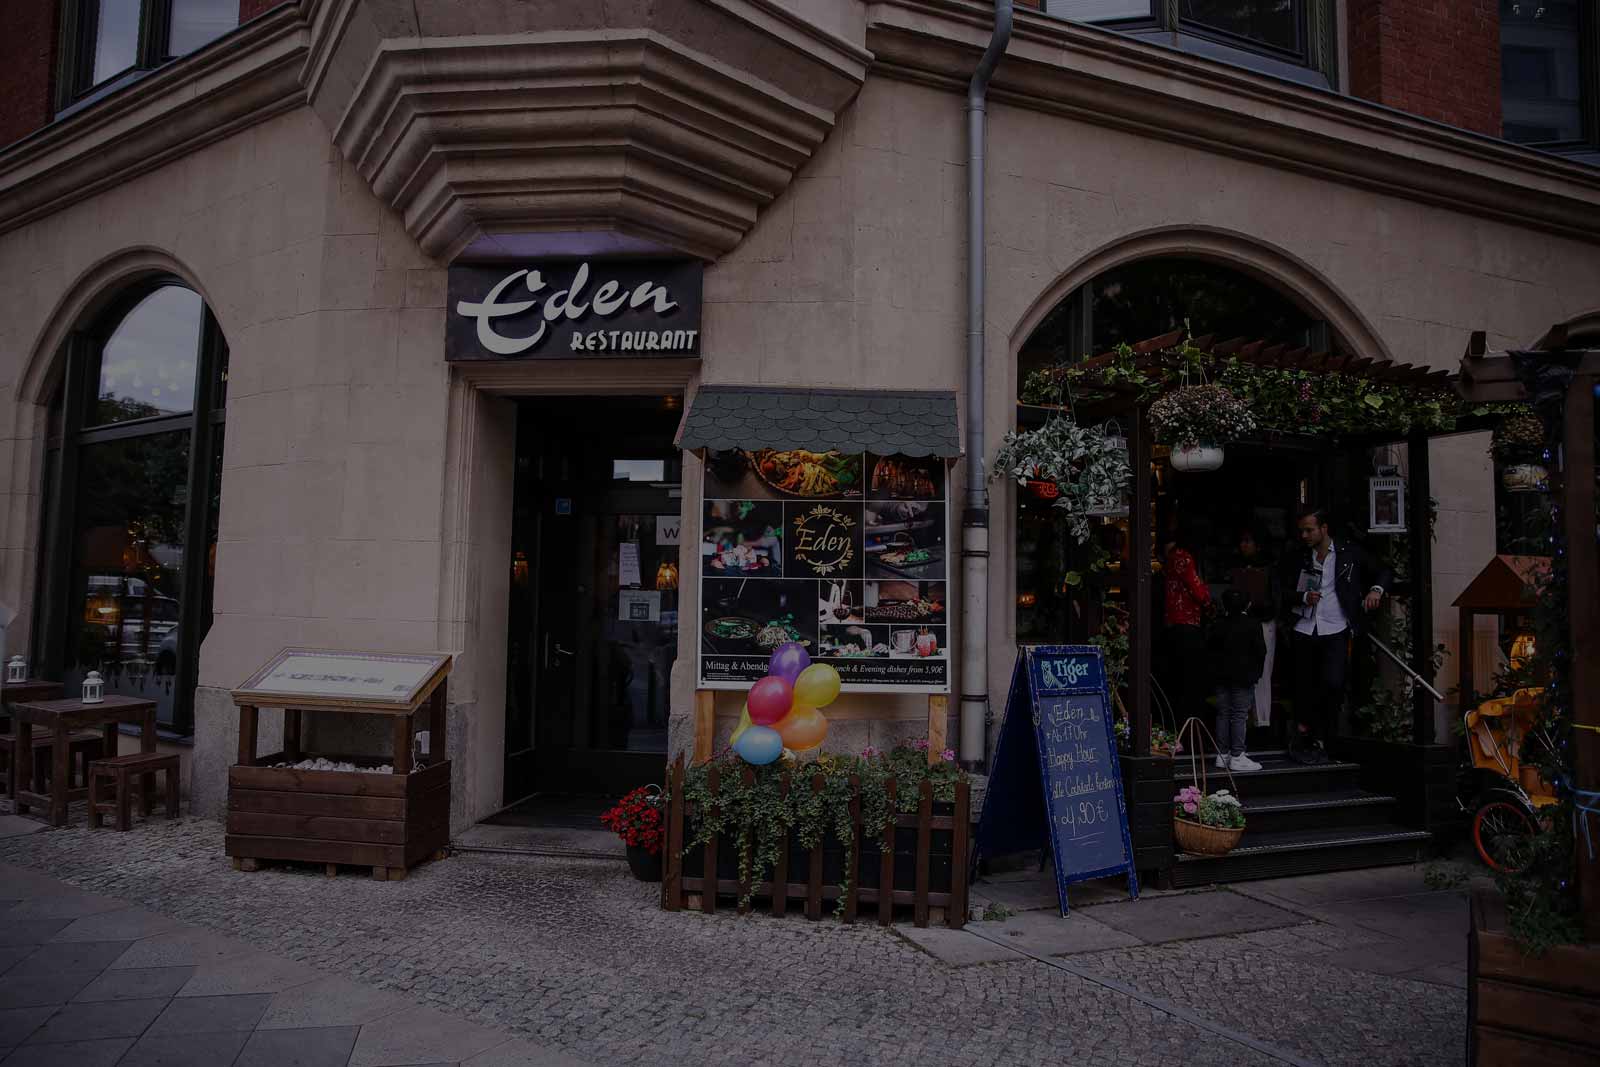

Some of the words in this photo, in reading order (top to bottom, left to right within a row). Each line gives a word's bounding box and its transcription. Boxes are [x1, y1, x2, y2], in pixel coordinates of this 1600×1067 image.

[457, 262, 679, 355] Eden
[570, 330, 698, 351] RESTAURANT
[795, 524, 852, 551] Eden
[705, 660, 730, 672] Mittag
[731, 660, 739, 670] &
[851, 664, 859, 673] &
[860, 664, 886, 675] Evening
[887, 664, 907, 674] dishes
[906, 664, 924, 675] from
[1053, 657, 1089, 685] Tiger
[1053, 699, 1085, 721] Eden
[1047, 746, 1074, 772] Happy
[1074, 743, 1097, 762] Hour
